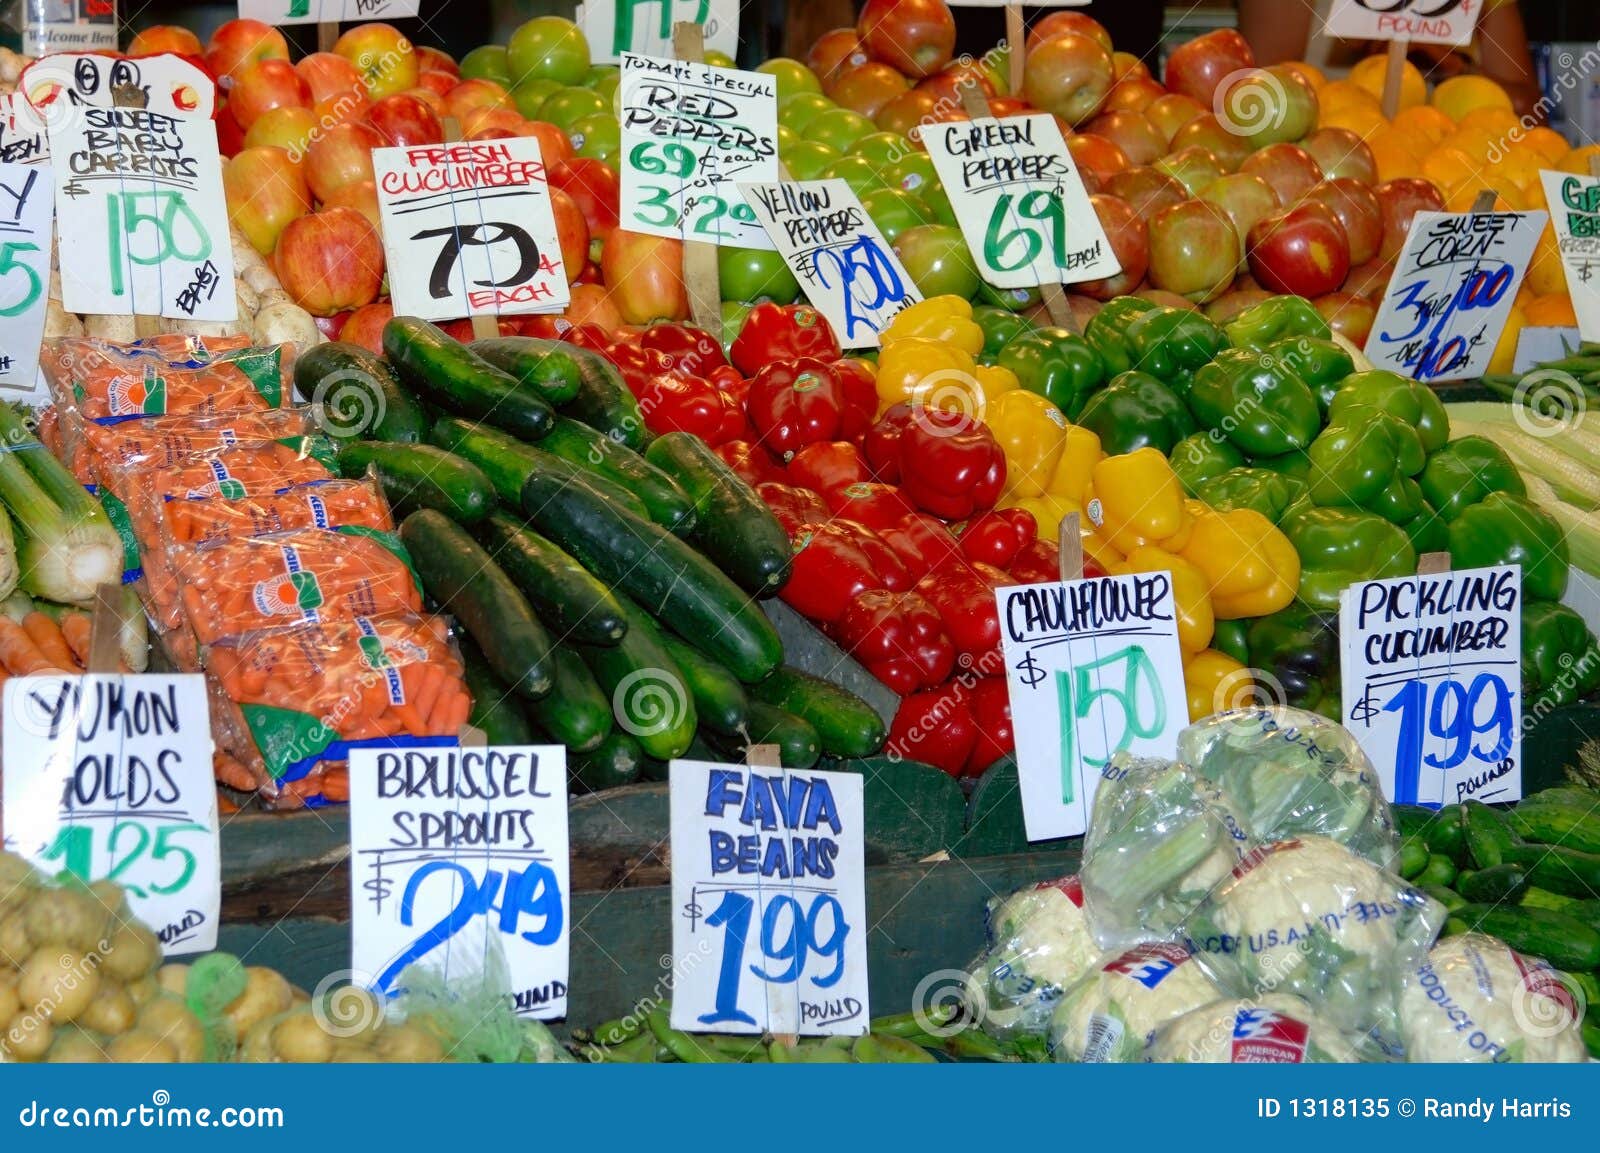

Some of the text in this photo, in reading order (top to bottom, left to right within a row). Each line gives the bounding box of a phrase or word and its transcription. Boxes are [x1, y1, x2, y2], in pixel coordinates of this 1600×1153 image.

[1377, 12, 1451, 37] POUND
[639, 85, 738, 119] RED
[702, 73, 774, 98] SPECIAL
[85, 110, 187, 136] SWEET
[624, 107, 775, 158] PEPPERS
[945, 118, 1035, 158] GREEN
[83, 129, 184, 160] BABY
[407, 143, 513, 169] FRESH
[70, 151, 199, 178] CARROTS
[381, 161, 546, 195] CUCUMBER
[963, 154, 1069, 188] PEPPERS
[633, 185, 678, 228] 3
[784, 206, 863, 249] PEPPERS
[1428, 213, 1527, 237] SWEET
[1066, 239, 1101, 270] EACH
[468, 281, 555, 309] EACH
[311, 496, 328, 530] KERN
[1358, 570, 1517, 630] PICKLING
[1365, 616, 1509, 665] CUCUMBER
[376, 751, 552, 800] BRUSSEL
[1456, 756, 1515, 802] POUND
[704, 768, 843, 837] FAVA
[389, 809, 536, 850] SPROUTS
[709, 828, 839, 881] BEANS
[799, 997, 864, 1026] POUND
